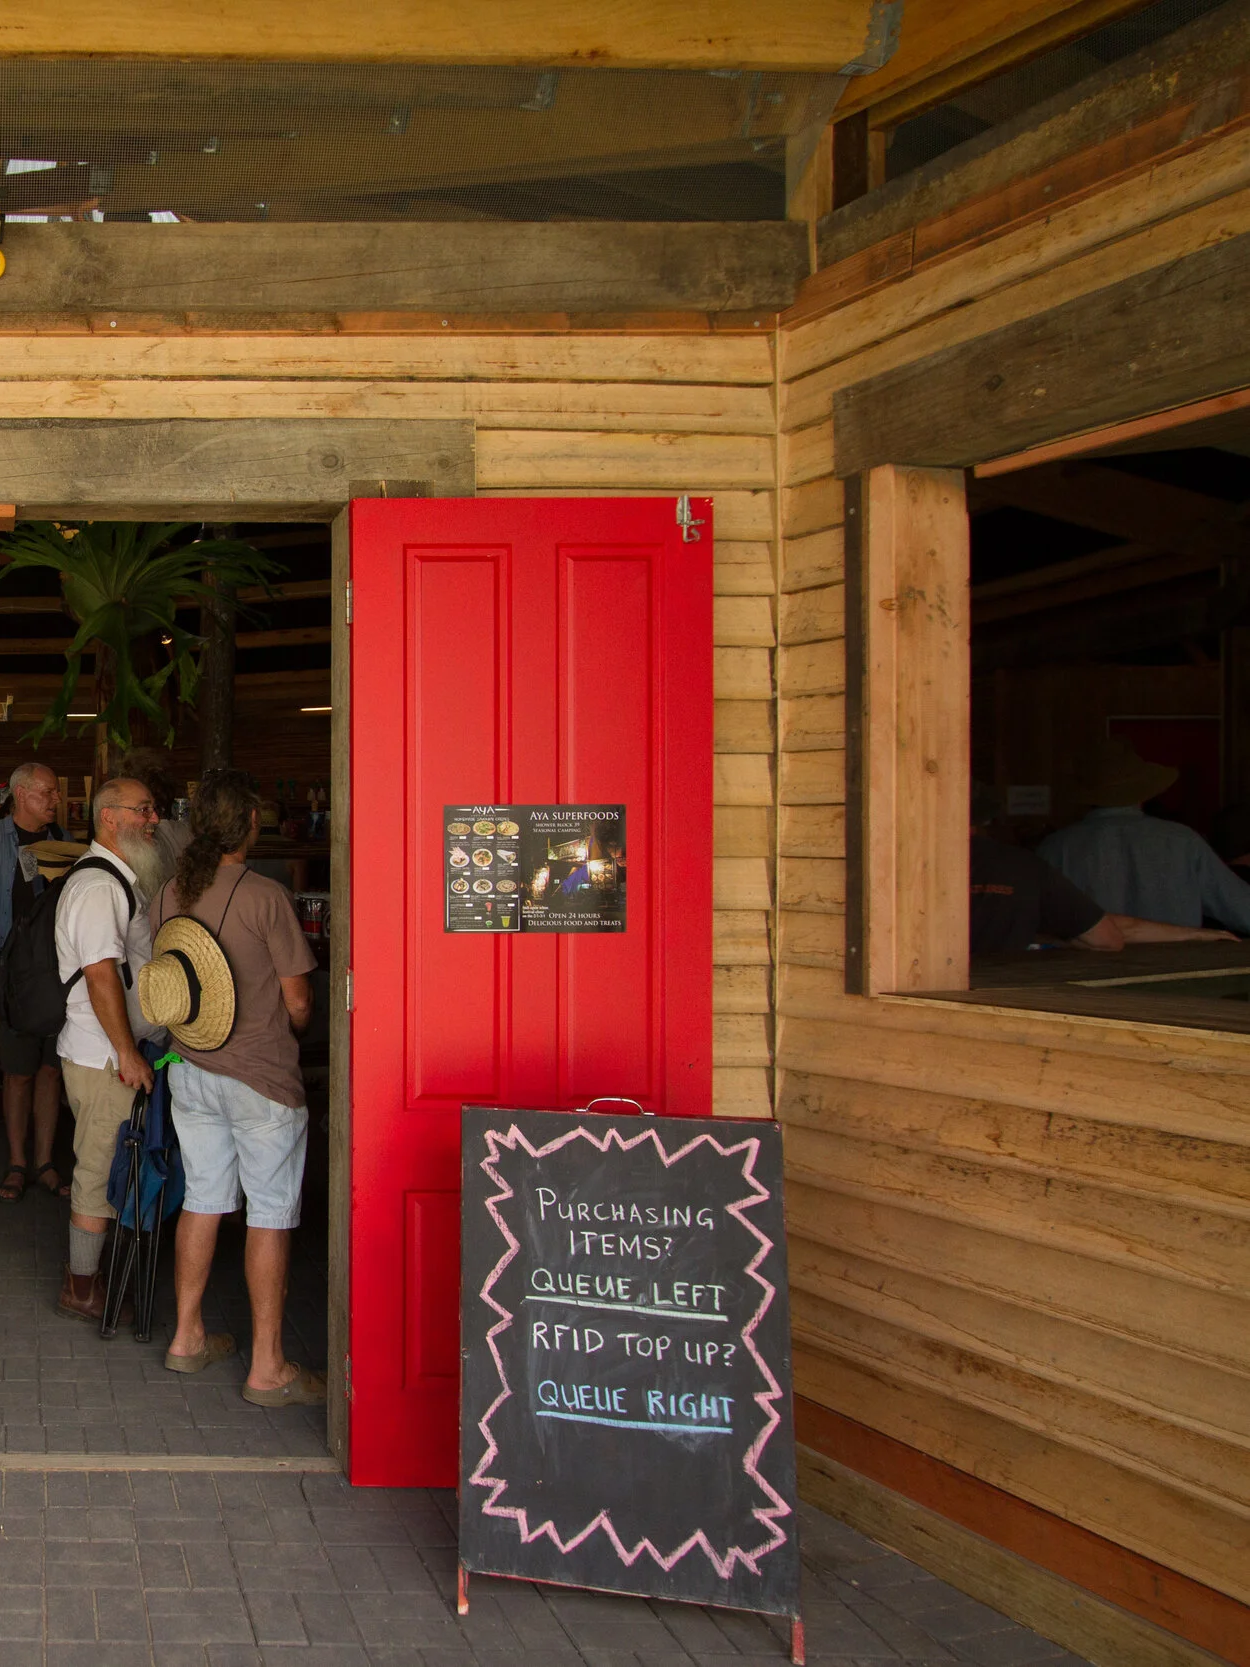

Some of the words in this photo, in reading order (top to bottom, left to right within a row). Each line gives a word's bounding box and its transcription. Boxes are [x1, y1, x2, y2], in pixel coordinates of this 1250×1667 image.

[529, 811, 549, 821] AYA
[552, 811, 619, 821] SUPERFOODS
[535, 1187, 715, 1231] PURCHASING
[568, 1230, 674, 1261] ITEMS?
[531, 1267, 632, 1300] QUEUE
[653, 1280, 727, 1311] LEFT
[532, 1320, 605, 1352] RFID
[617, 1332, 670, 1361] TOP
[684, 1339, 736, 1368] UP?
[537, 1379, 628, 1413] QUEUE
[647, 1388, 735, 1424] RIGHT
